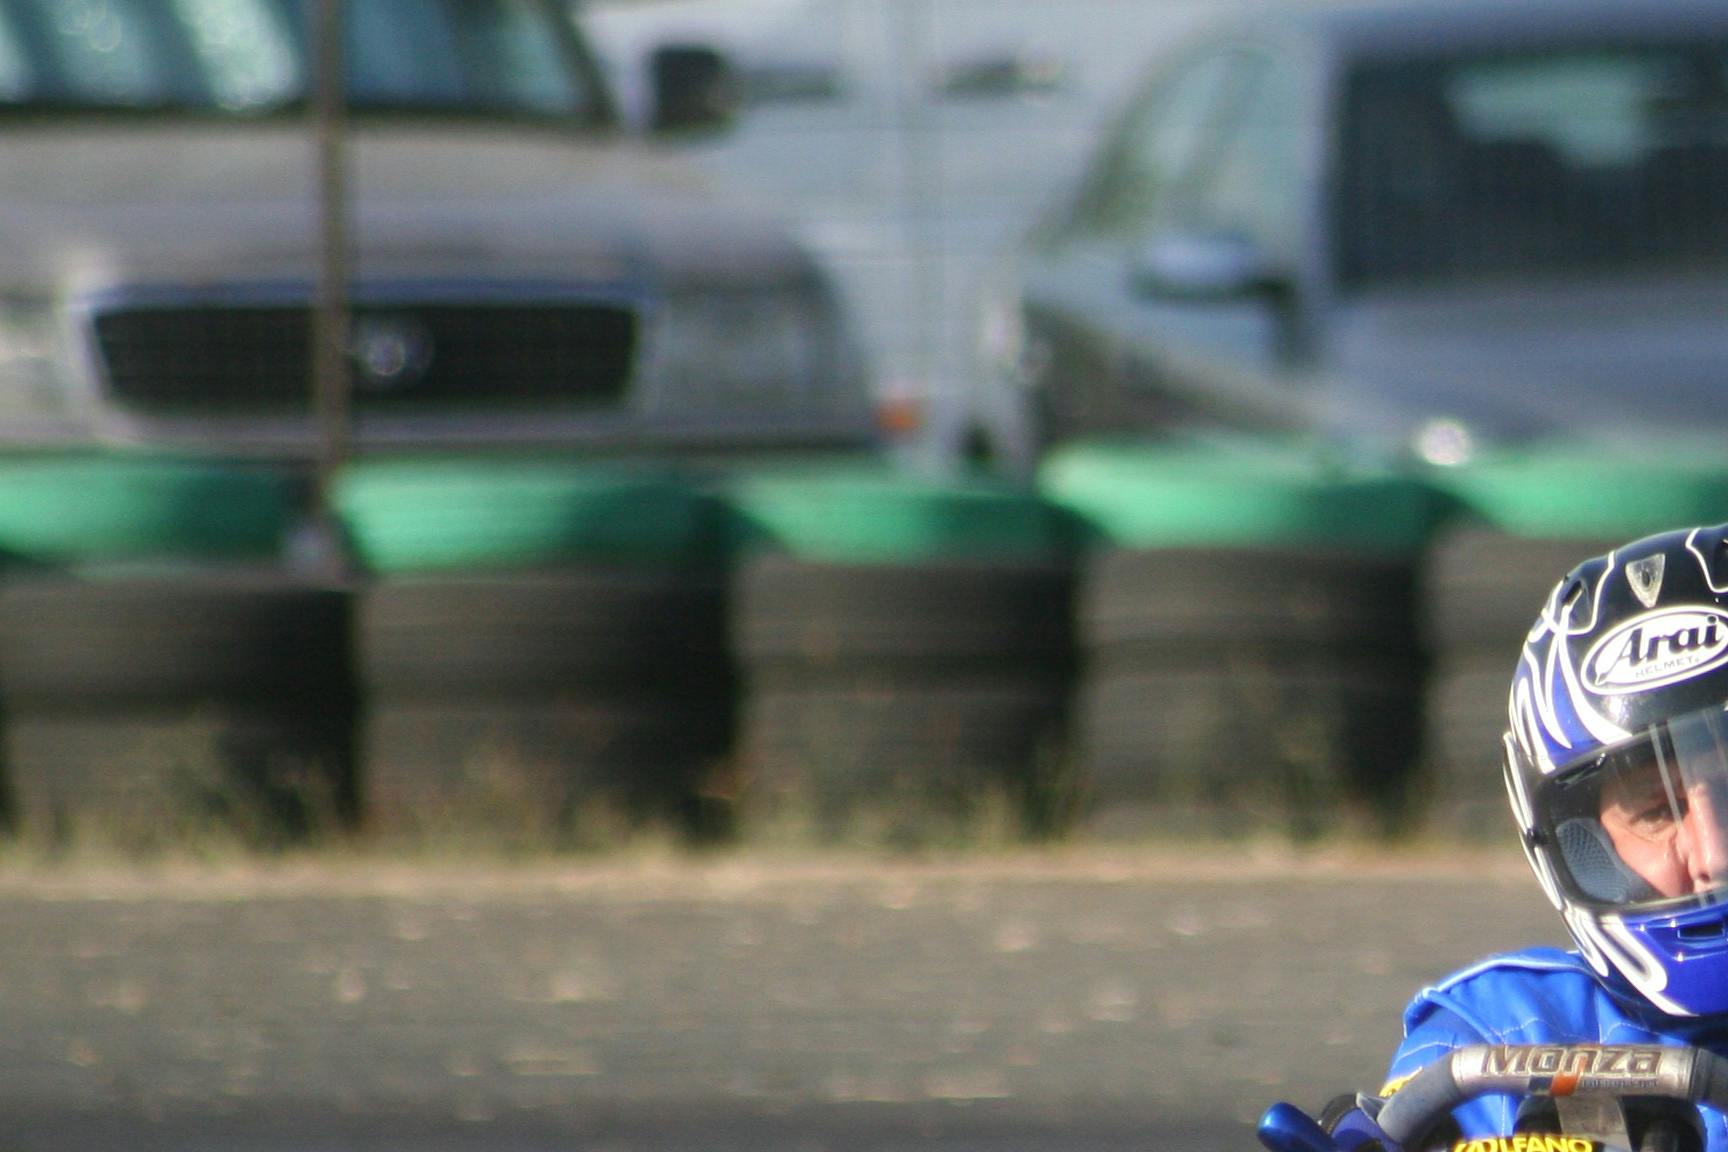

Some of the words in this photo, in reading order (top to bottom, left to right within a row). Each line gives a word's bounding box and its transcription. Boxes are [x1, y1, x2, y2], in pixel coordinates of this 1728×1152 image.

[1595, 615, 1724, 684] Arai
[1635, 656, 1694, 678] HELMET
[1481, 1047, 1663, 1076] Monza
